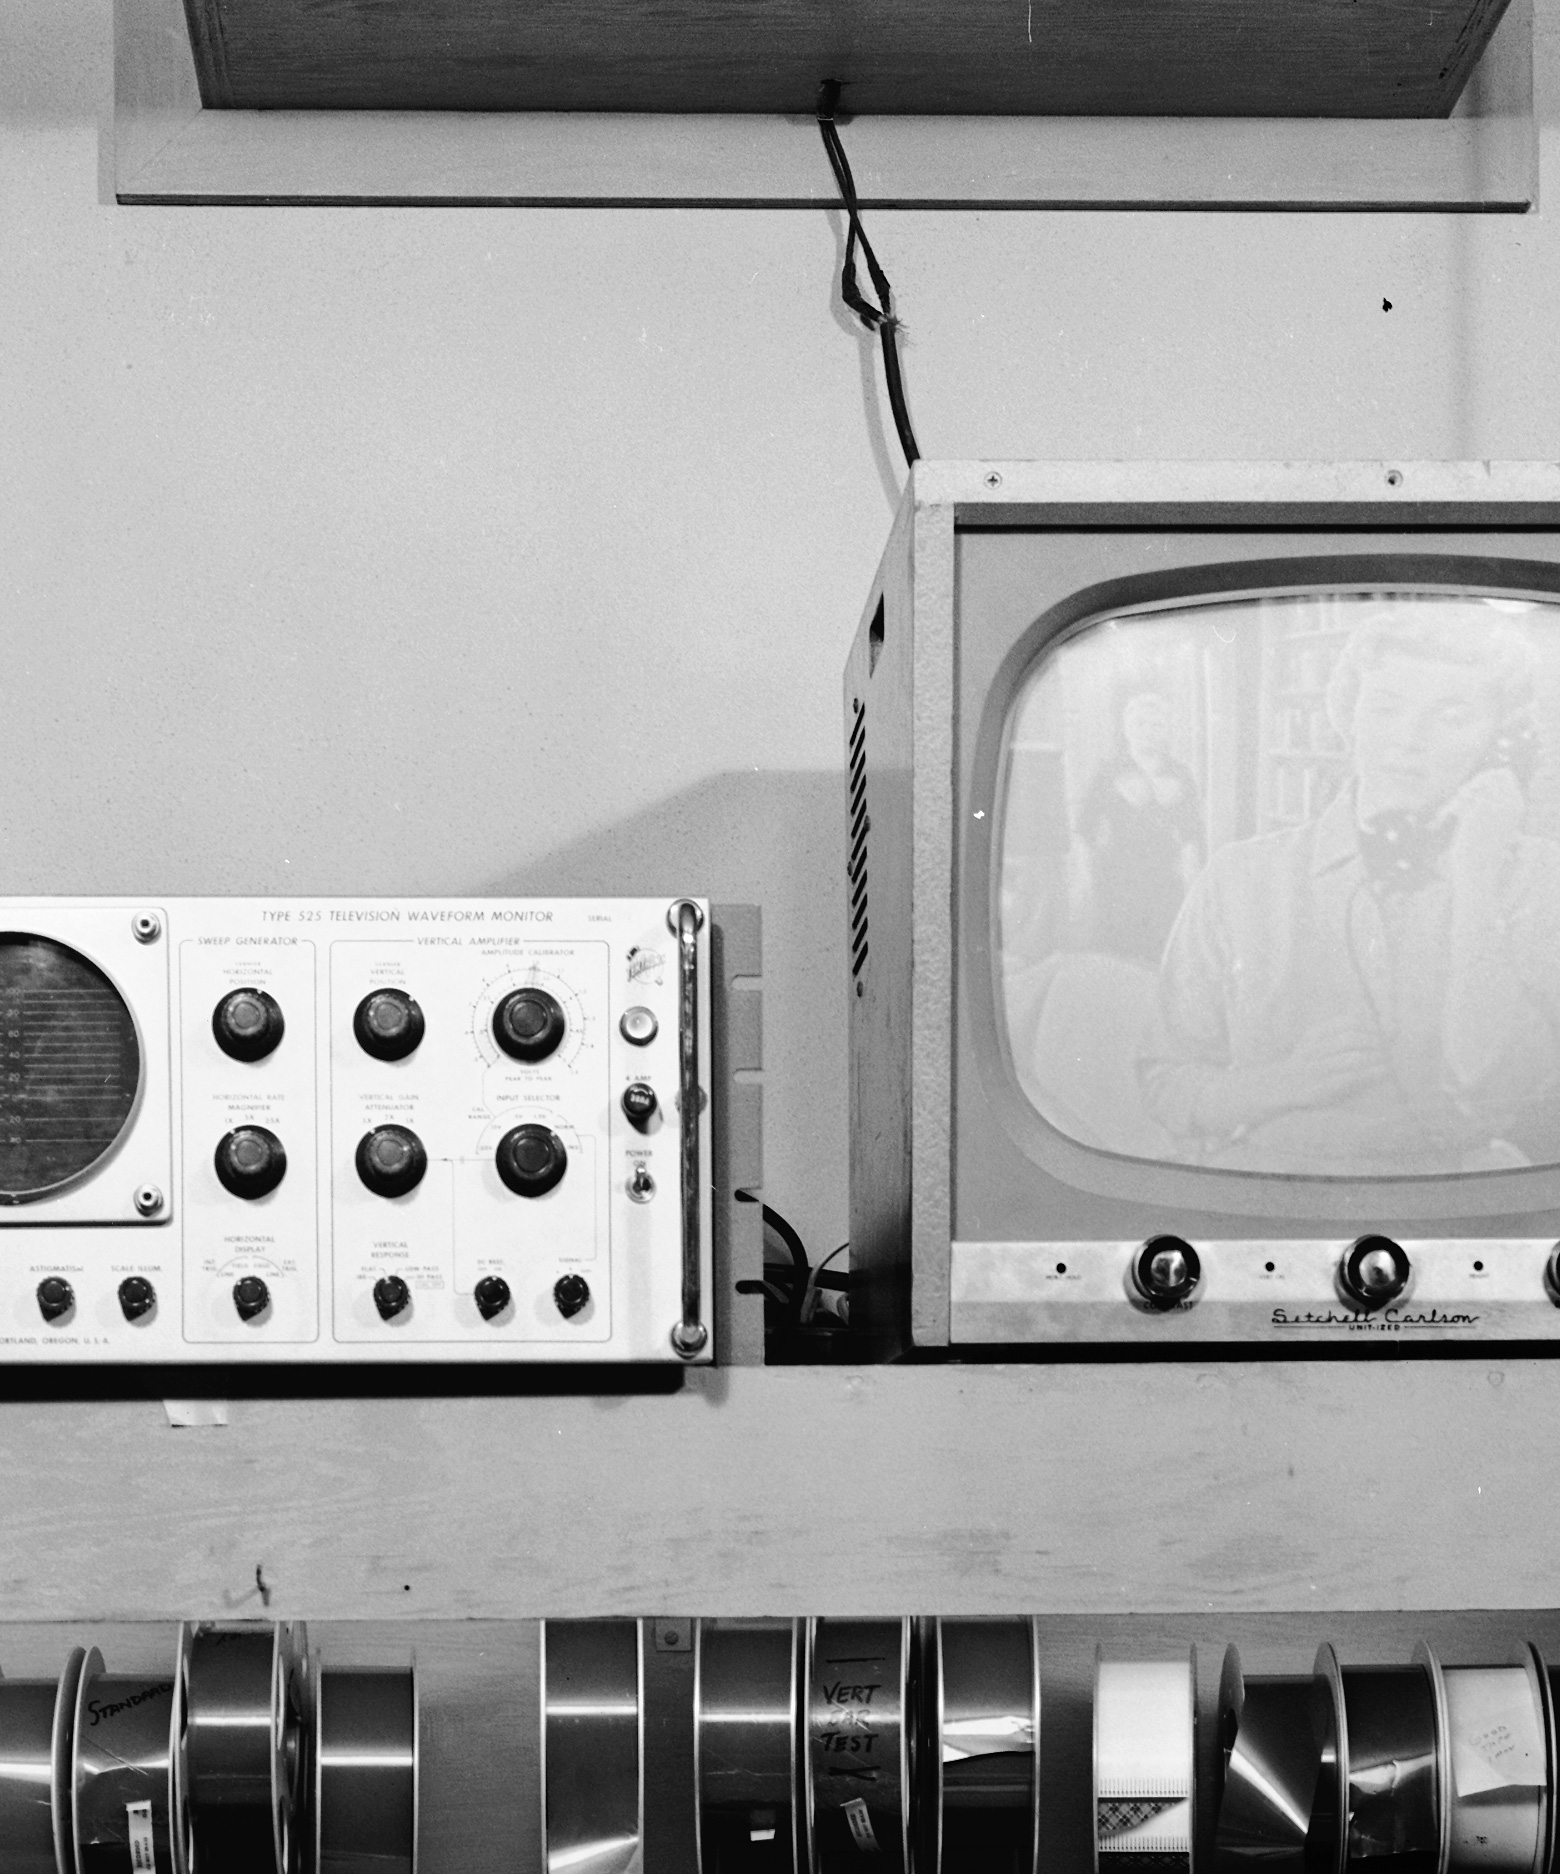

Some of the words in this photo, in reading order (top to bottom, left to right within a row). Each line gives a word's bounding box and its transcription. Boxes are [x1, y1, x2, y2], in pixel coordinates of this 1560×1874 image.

[262, 910, 291, 922] TYPE
[298, 910, 322, 922] 525
[329, 910, 401, 922] TELEVISION
[407, 910, 485, 922] WAVEFORM
[491, 910, 554, 922] MONITOR
[197, 936, 231, 946] SWEEP
[235, 936, 298, 946] GENERATOR
[417, 936, 464, 946] VERTICAL
[468, 936, 520, 946] AMPLIFIER
[223, 968, 273, 976] HORIZONTAL
[370, 968, 405, 976] VERTICAL
[229, 978, 266, 986] POSITION
[369, 978, 406, 986] POSITION
[212, 1094, 263, 1102] HORIZONTAL
[359, 1094, 393, 1102] VERTICAL
[224, 1236, 275, 1244] HORIZONTAL
[373, 1241, 408, 1249] VERTICAL
[1271, 1308, 1377, 1324] Setchell
[1384, 1308, 1480, 1324] Carlson
[822, 1680, 882, 1704] VERT
[89, 1682, 174, 1726] STANDARD
[820, 1731, 879, 1752] TEST
